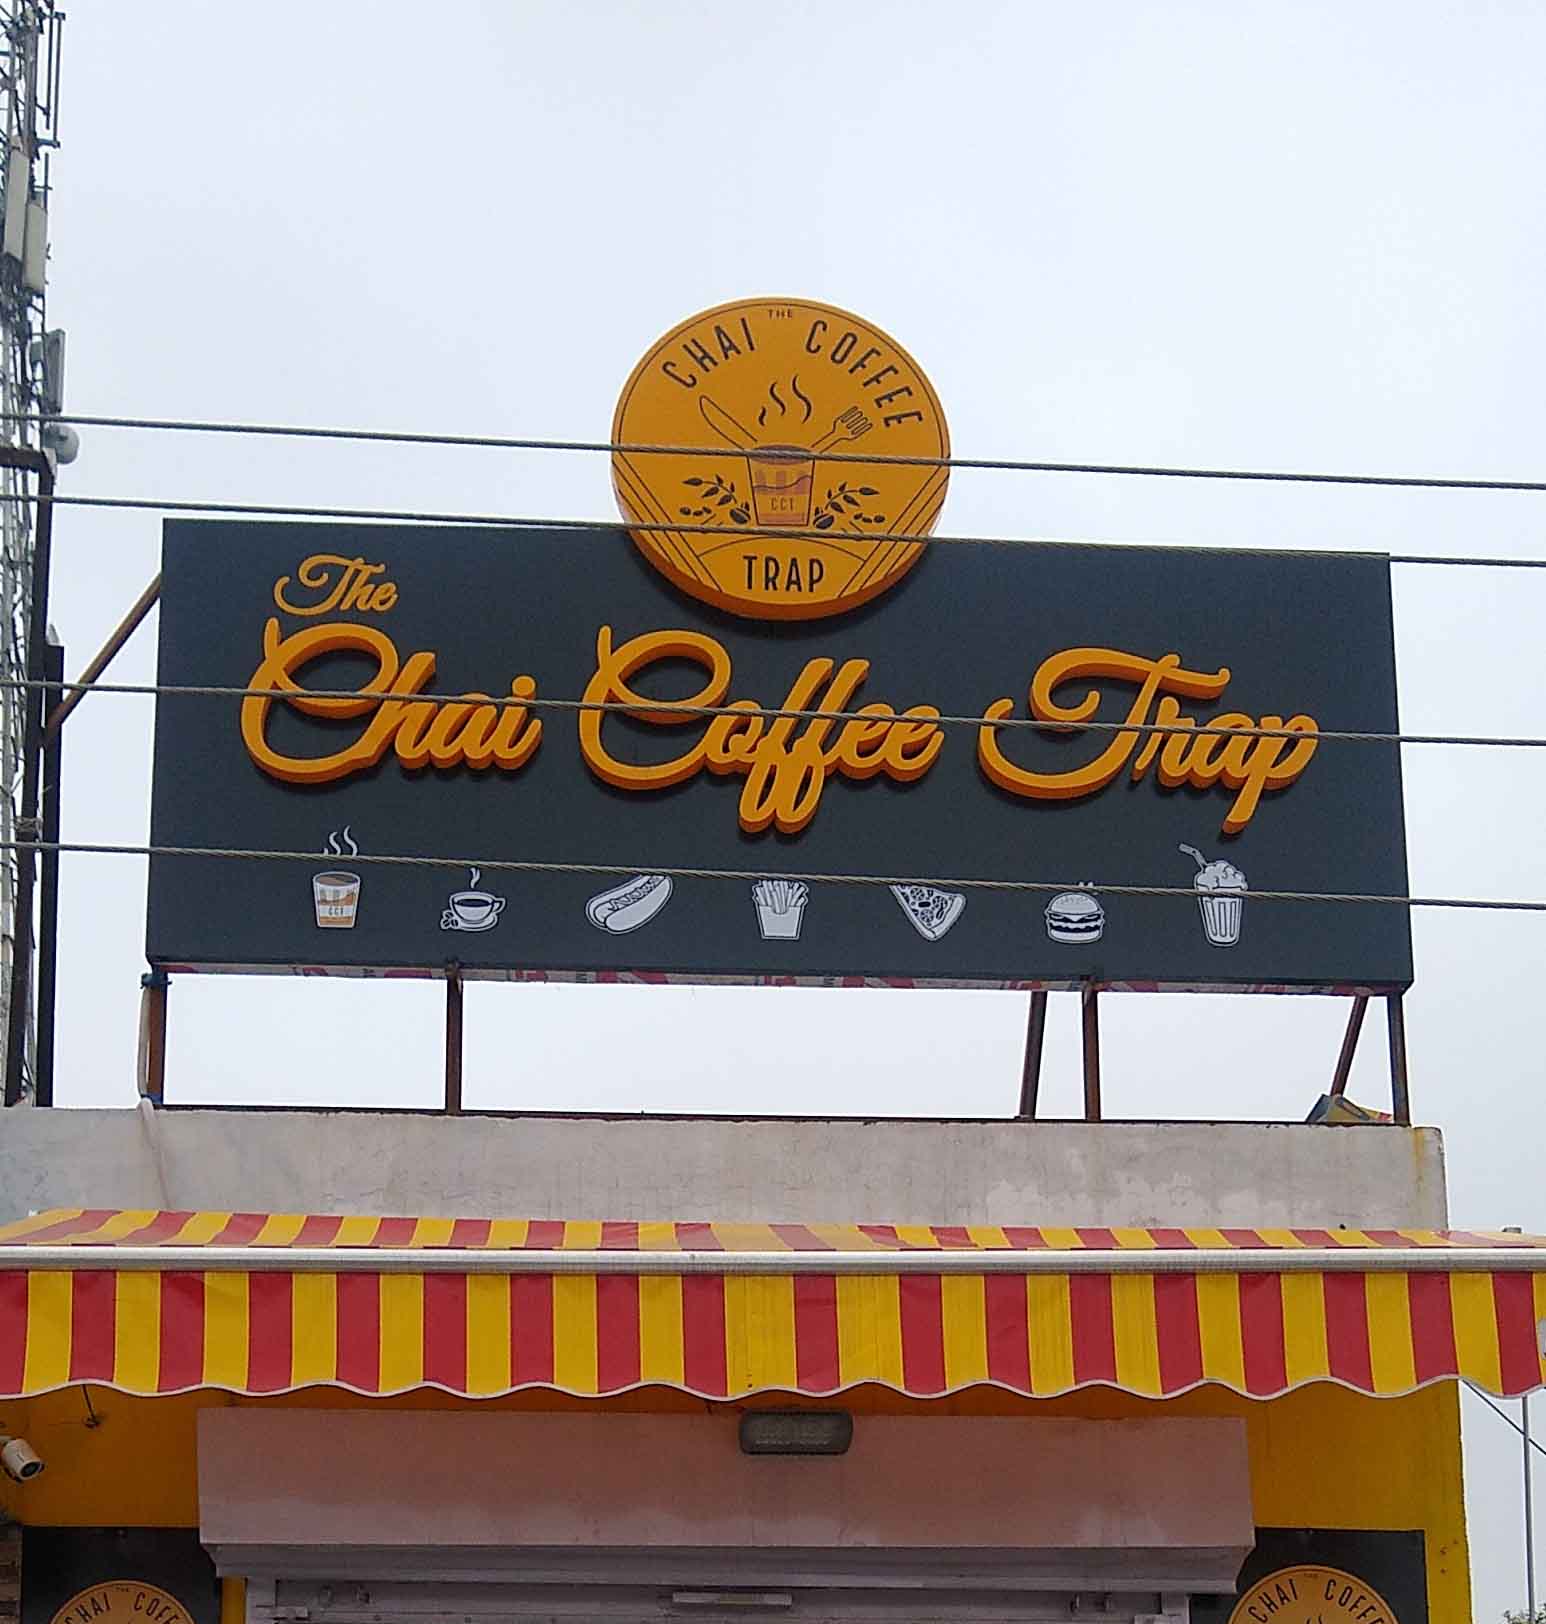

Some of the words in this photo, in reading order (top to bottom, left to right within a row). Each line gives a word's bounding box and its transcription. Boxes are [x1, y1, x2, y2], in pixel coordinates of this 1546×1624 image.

[768, 309, 794, 320] THE
[661, 317, 756, 389] CHAI
[804, 319, 924, 428] COFFEE
[273, 554, 398, 616] The
[742, 554, 825, 593] TRAP
[240, 617, 543, 784] Chai
[579, 624, 945, 834] Coffee
[976, 646, 1319, 835] Trap
[1247, 1577, 1300, 1624] CHAI
